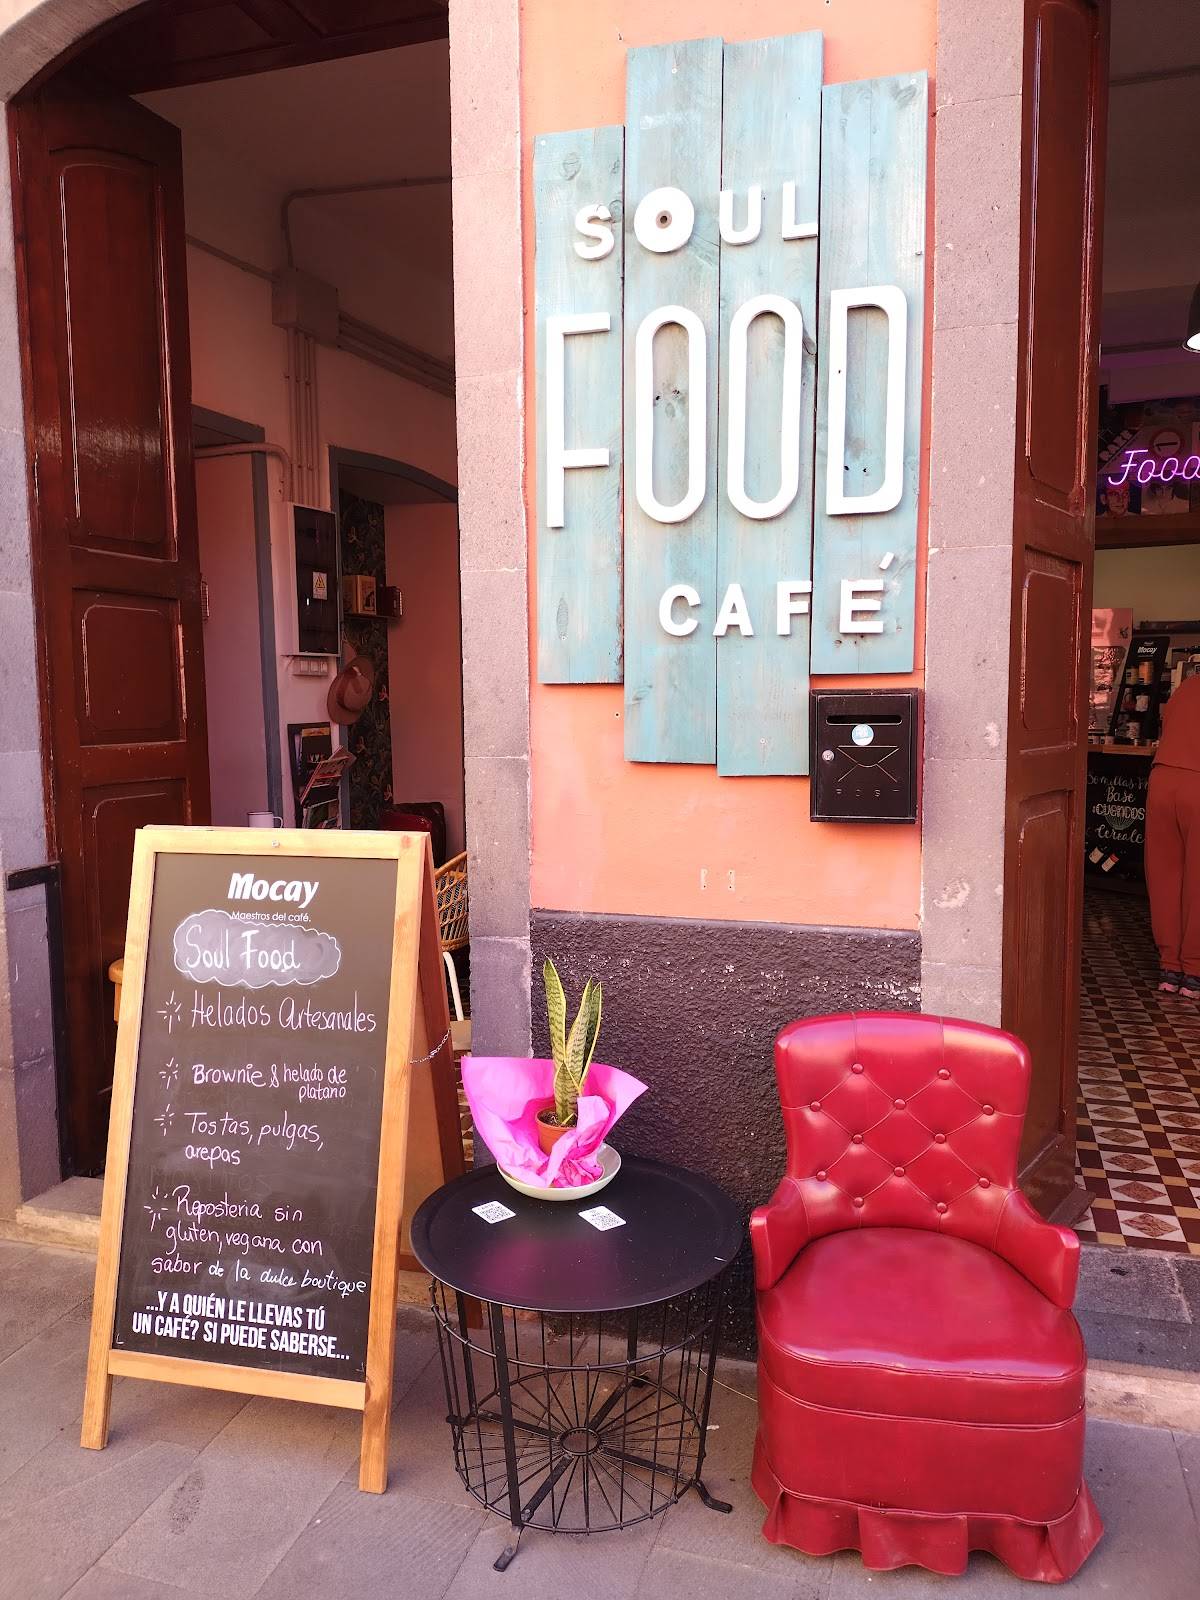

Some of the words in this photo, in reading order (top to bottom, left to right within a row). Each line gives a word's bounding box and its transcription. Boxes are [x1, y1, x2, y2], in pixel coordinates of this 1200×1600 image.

[573, 182, 818, 261] SOUL
[546, 285, 908, 528] FOOD
[658, 551, 895, 637] CAFÉ
[228, 873, 319, 908] Mocay
[232, 912, 270, 920] Maestros
[272, 913, 285, 921] del
[186, 925, 229, 969] Soul
[240, 930, 300, 972] Food
[192, 990, 270, 1028] Helados
[192, 1064, 266, 1087] Brownie
[283, 1063, 323, 1083] helado
[328, 1066, 347, 1083] de
[185, 1145, 241, 1169] arepas
[274, 1205, 302, 1222] sin
[292, 1239, 323, 1256] con
[152, 1255, 202, 1274] sabor
[208, 1260, 224, 1277] de
[235, 1259, 251, 1282] la
[260, 1268, 297, 1287] dulce
[301, 1269, 367, 1298] boutique
[169, 1293, 180, 1314] A
[183, 1292, 225, 1320] QUIÉN
[229, 1299, 246, 1322] LE
[249, 1301, 302, 1328] LLEVAS
[306, 1305, 325, 1331] TÚ
[132, 1312, 152, 1335] UN
[155, 1313, 198, 1341] CAFÉ?
[204, 1321, 218, 1343] SI
[220, 1322, 267, 1350] PUEDE
[270, 1329, 350, 1360] SABERSE...
